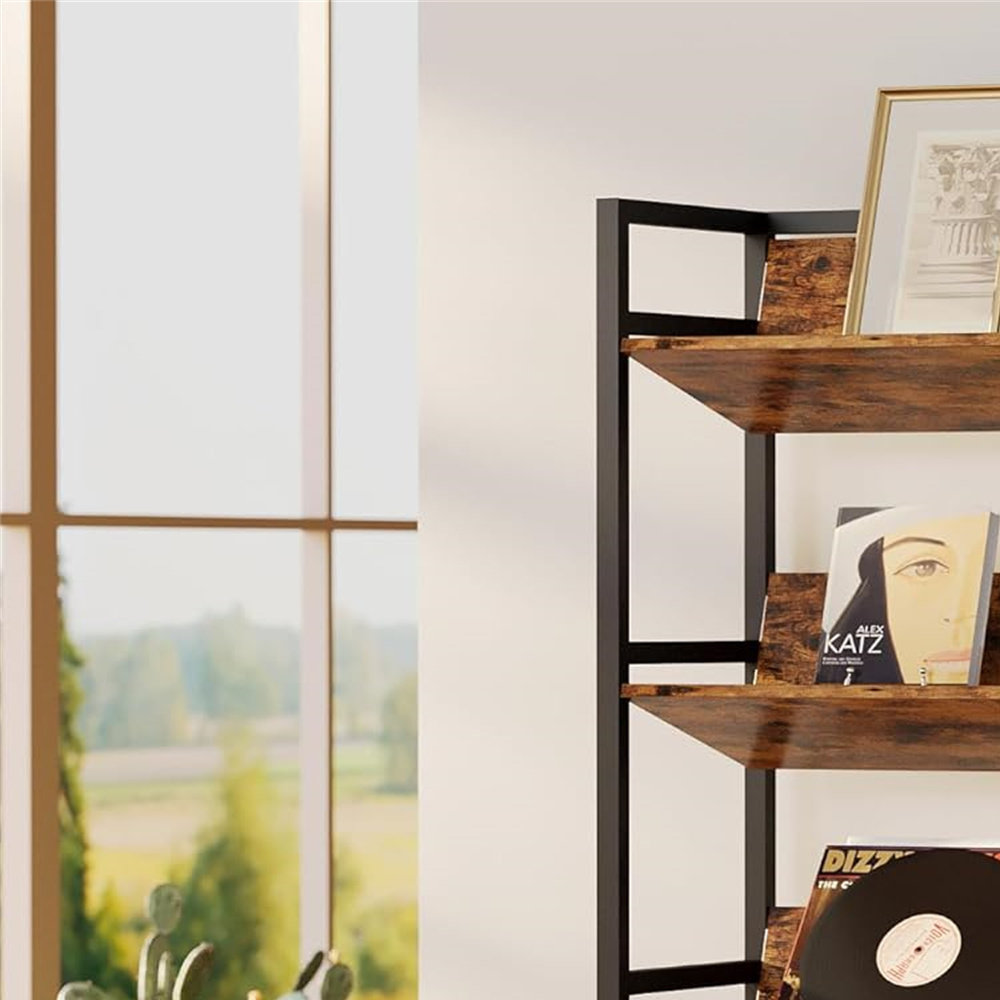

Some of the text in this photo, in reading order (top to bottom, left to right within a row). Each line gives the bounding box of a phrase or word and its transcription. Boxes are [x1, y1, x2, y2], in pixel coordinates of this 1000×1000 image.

[856, 624, 885, 633] ALEX
[823, 632, 884, 654] KATZ
[822, 849, 915, 873] DIZZ
[817, 880, 839, 889] THE
